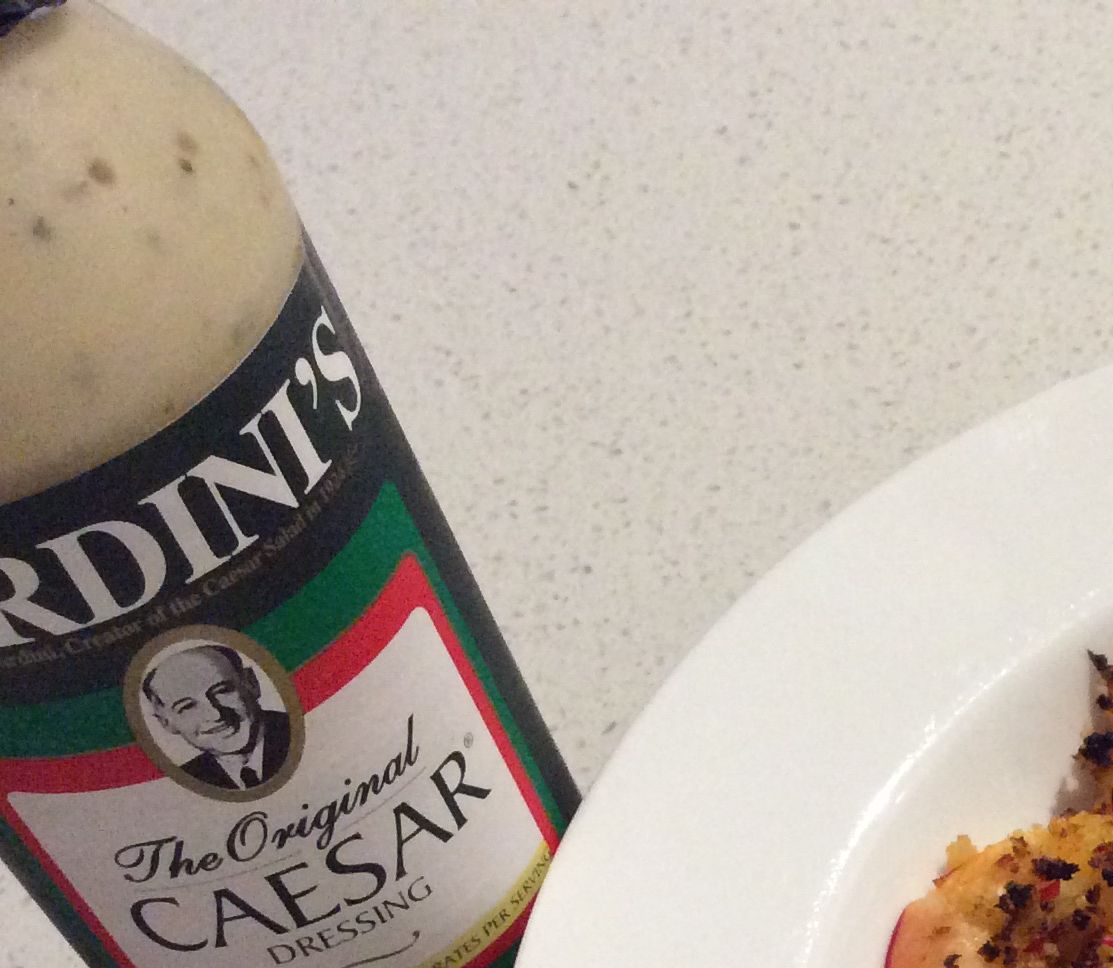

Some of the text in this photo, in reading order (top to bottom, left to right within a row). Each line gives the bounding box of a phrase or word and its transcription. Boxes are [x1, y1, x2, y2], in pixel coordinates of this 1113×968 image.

[114, 714, 420, 884] The Original
[130, 751, 492, 952] CAESAR
[267, 876, 433, 965] DRESSING
[483, 907, 512, 937] PER
